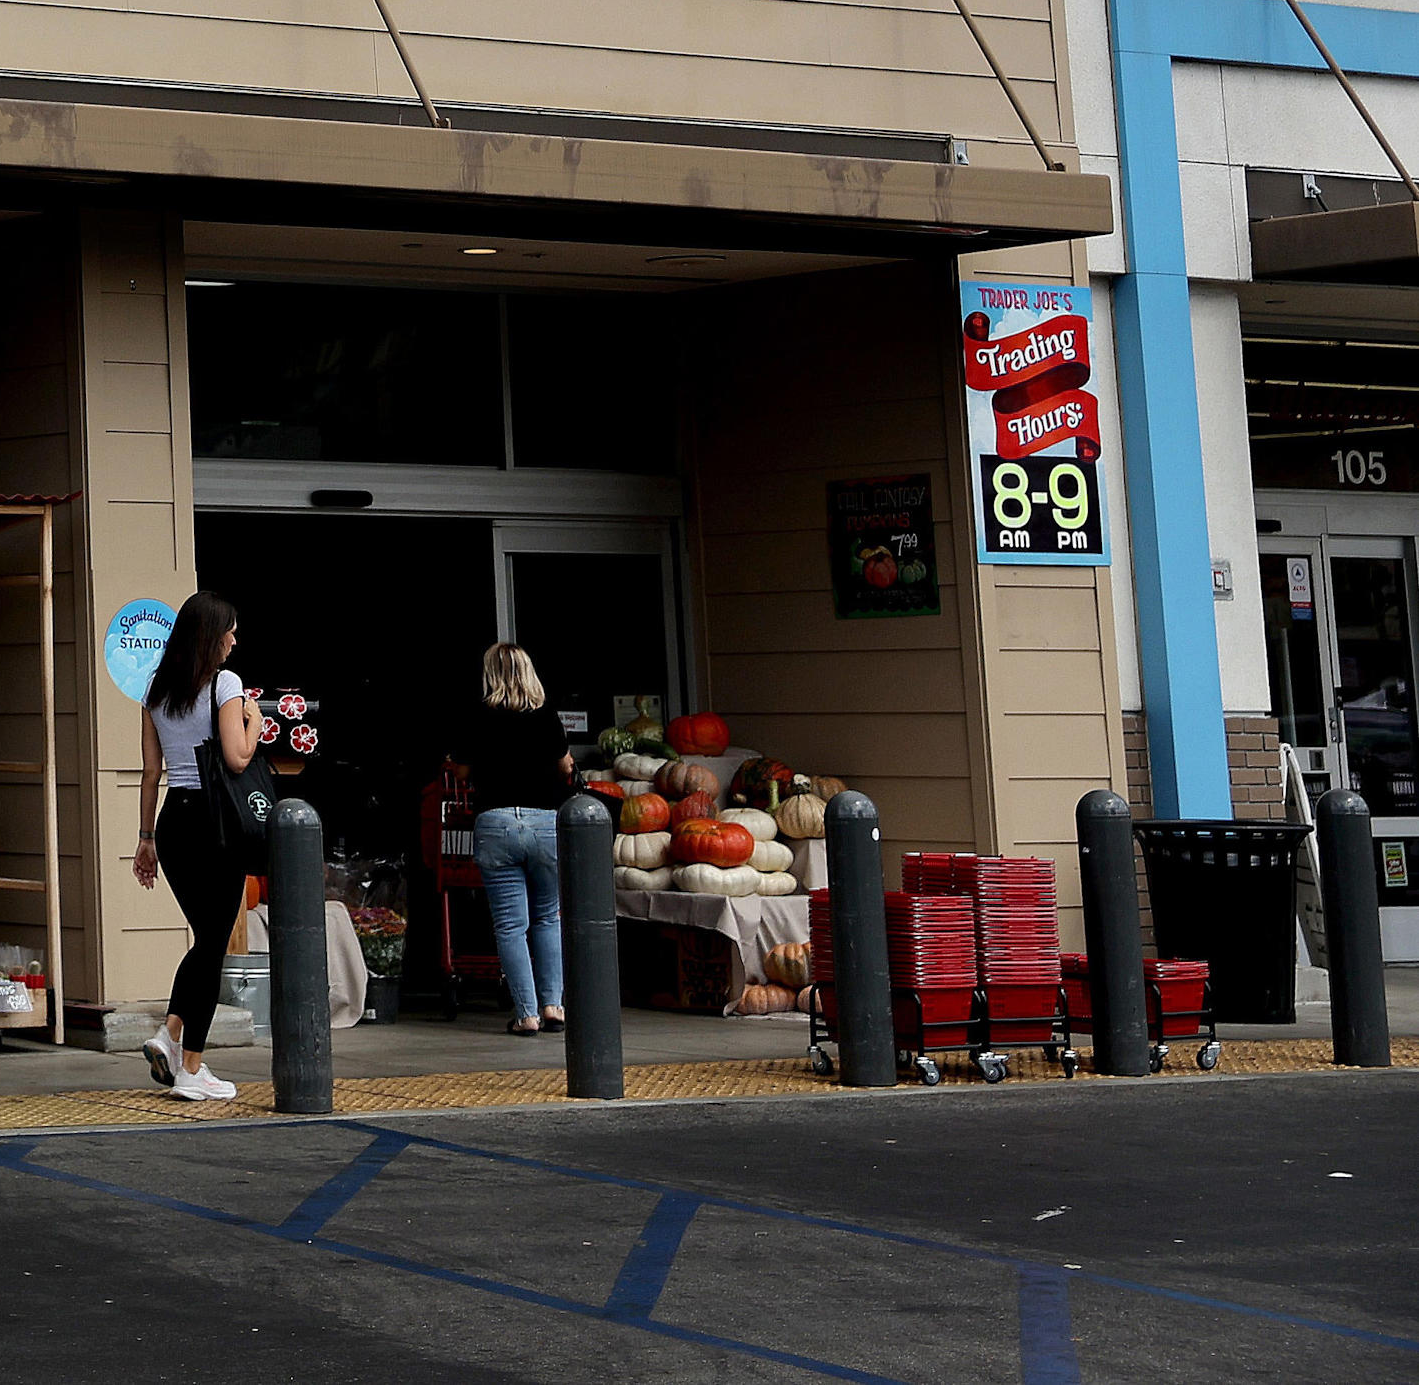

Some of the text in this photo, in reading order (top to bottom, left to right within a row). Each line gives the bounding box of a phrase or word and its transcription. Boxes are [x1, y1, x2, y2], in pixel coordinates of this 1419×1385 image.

[977, 287, 1074, 312] TRADER JOE'S
[975, 329, 1076, 378] Trading
[1007, 401, 1084, 447] Hours:
[1330, 450, 1387, 485] 105
[992, 462, 1089, 530] 8-9
[999, 529, 1088, 550] AM PM
[119, 608, 173, 635] Sanitation
